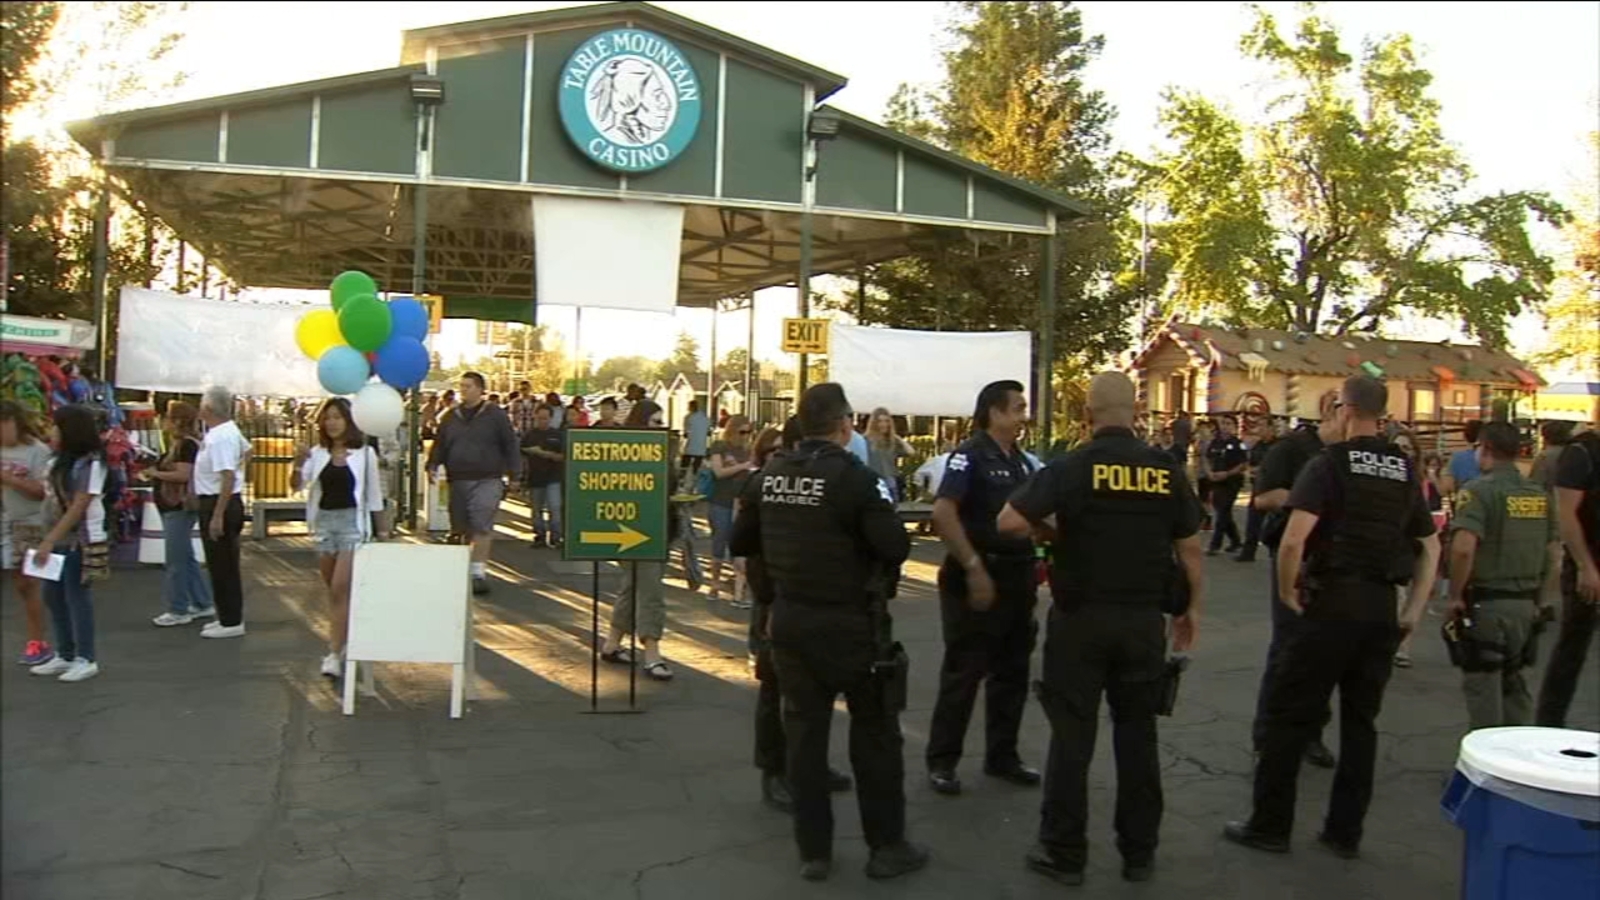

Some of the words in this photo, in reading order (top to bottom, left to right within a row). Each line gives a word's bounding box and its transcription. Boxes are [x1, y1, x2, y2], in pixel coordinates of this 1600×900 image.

[564, 38, 612, 90] TABLE
[612, 32, 700, 102] MOUNTAIN
[589, 138, 670, 168] CASINO
[787, 322, 822, 342] EXIT
[572, 442, 663, 462] RESTROOMS
[1349, 450, 1408, 471] POLICE
[579, 472, 655, 491] SHOPPING
[762, 475, 825, 497] POLICE
[1093, 464, 1171, 494] POLICE
[762, 494, 821, 506] MAGEC
[596, 502, 637, 521] FOOD
